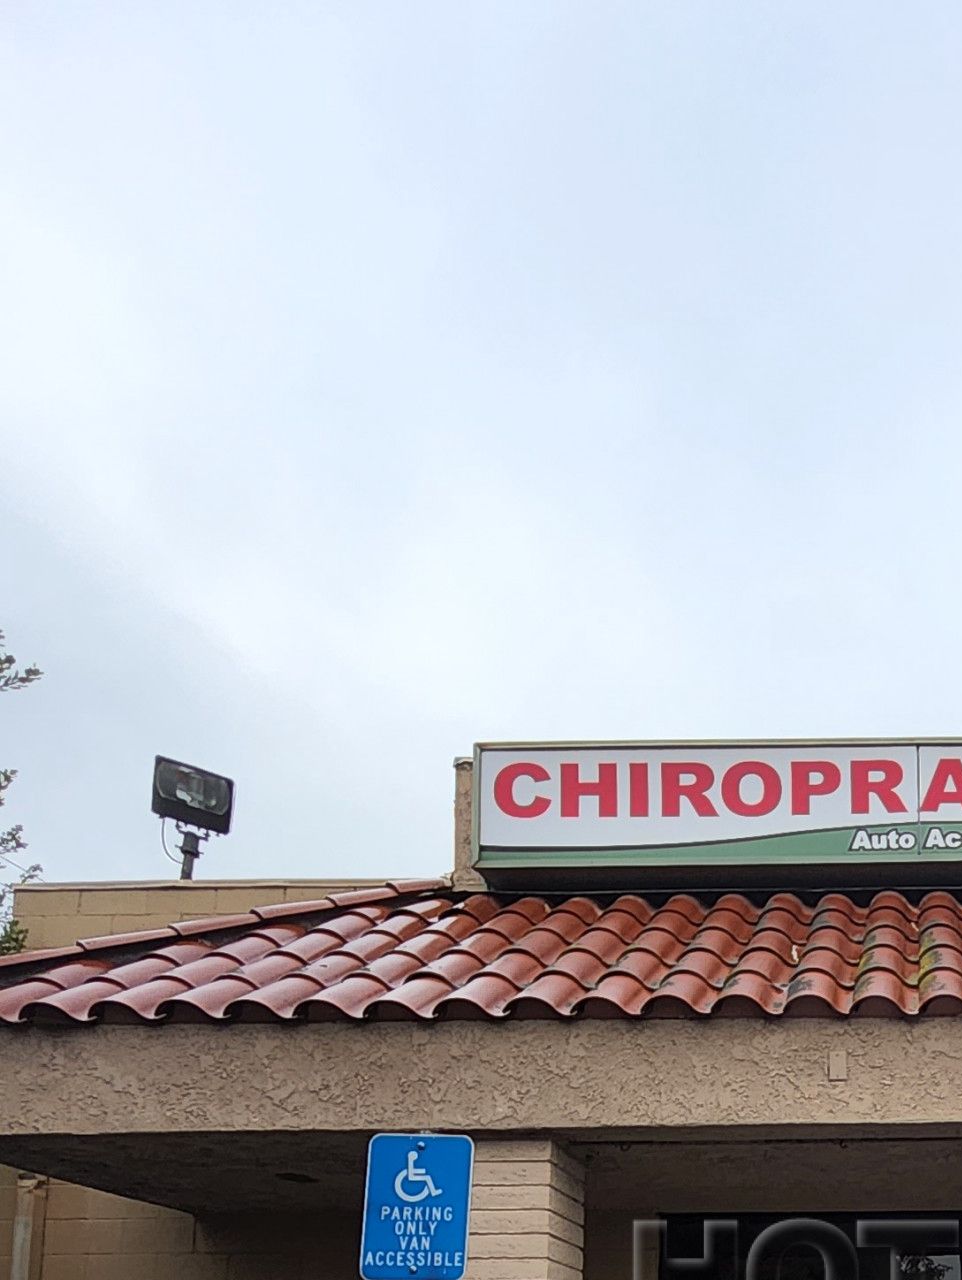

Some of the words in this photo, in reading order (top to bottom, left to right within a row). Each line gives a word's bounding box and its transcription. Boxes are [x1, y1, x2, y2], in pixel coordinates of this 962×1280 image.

[850, 828, 917, 851] Auto
[381, 1206, 453, 1221] PARKING
[395, 1221, 438, 1236] ONLY
[399, 1236, 430, 1250] VAN
[364, 1252, 463, 1267] ACCESSIBLE
